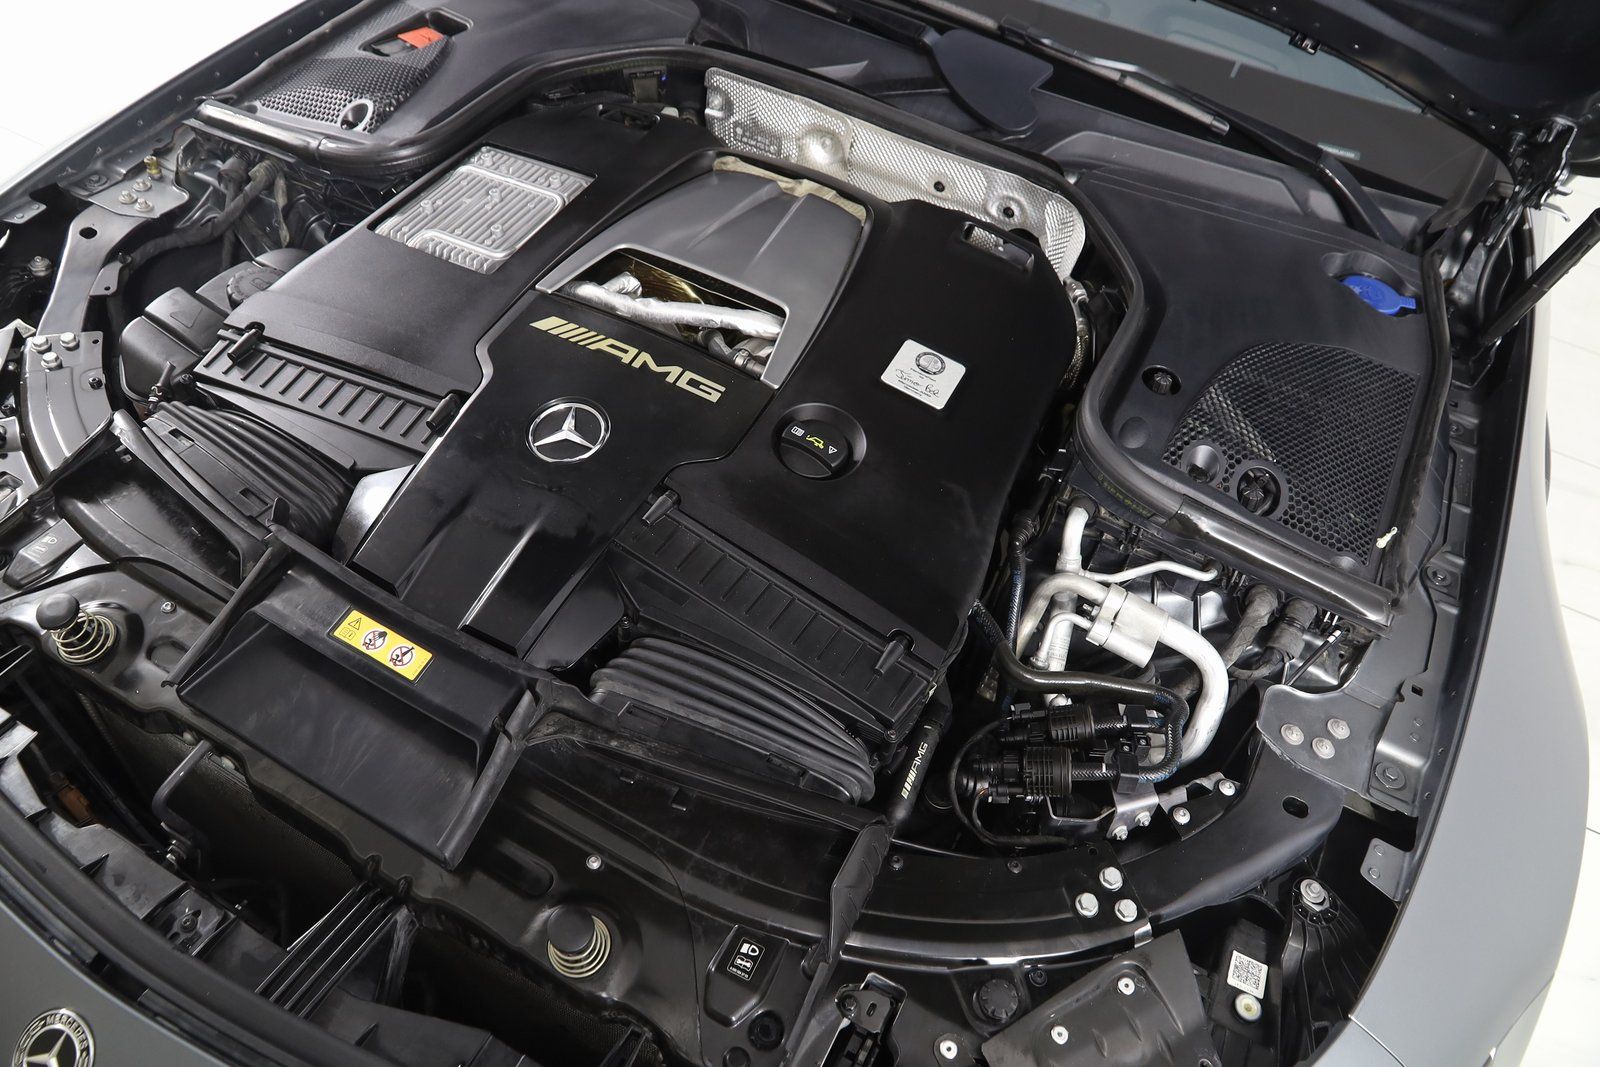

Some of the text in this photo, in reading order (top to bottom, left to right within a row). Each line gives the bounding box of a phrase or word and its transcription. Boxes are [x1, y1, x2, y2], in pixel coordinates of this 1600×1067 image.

[586, 337, 726, 403] AMG
[911, 741, 929, 774] AMG
[46, 1013, 89, 1050] MERCEDES
